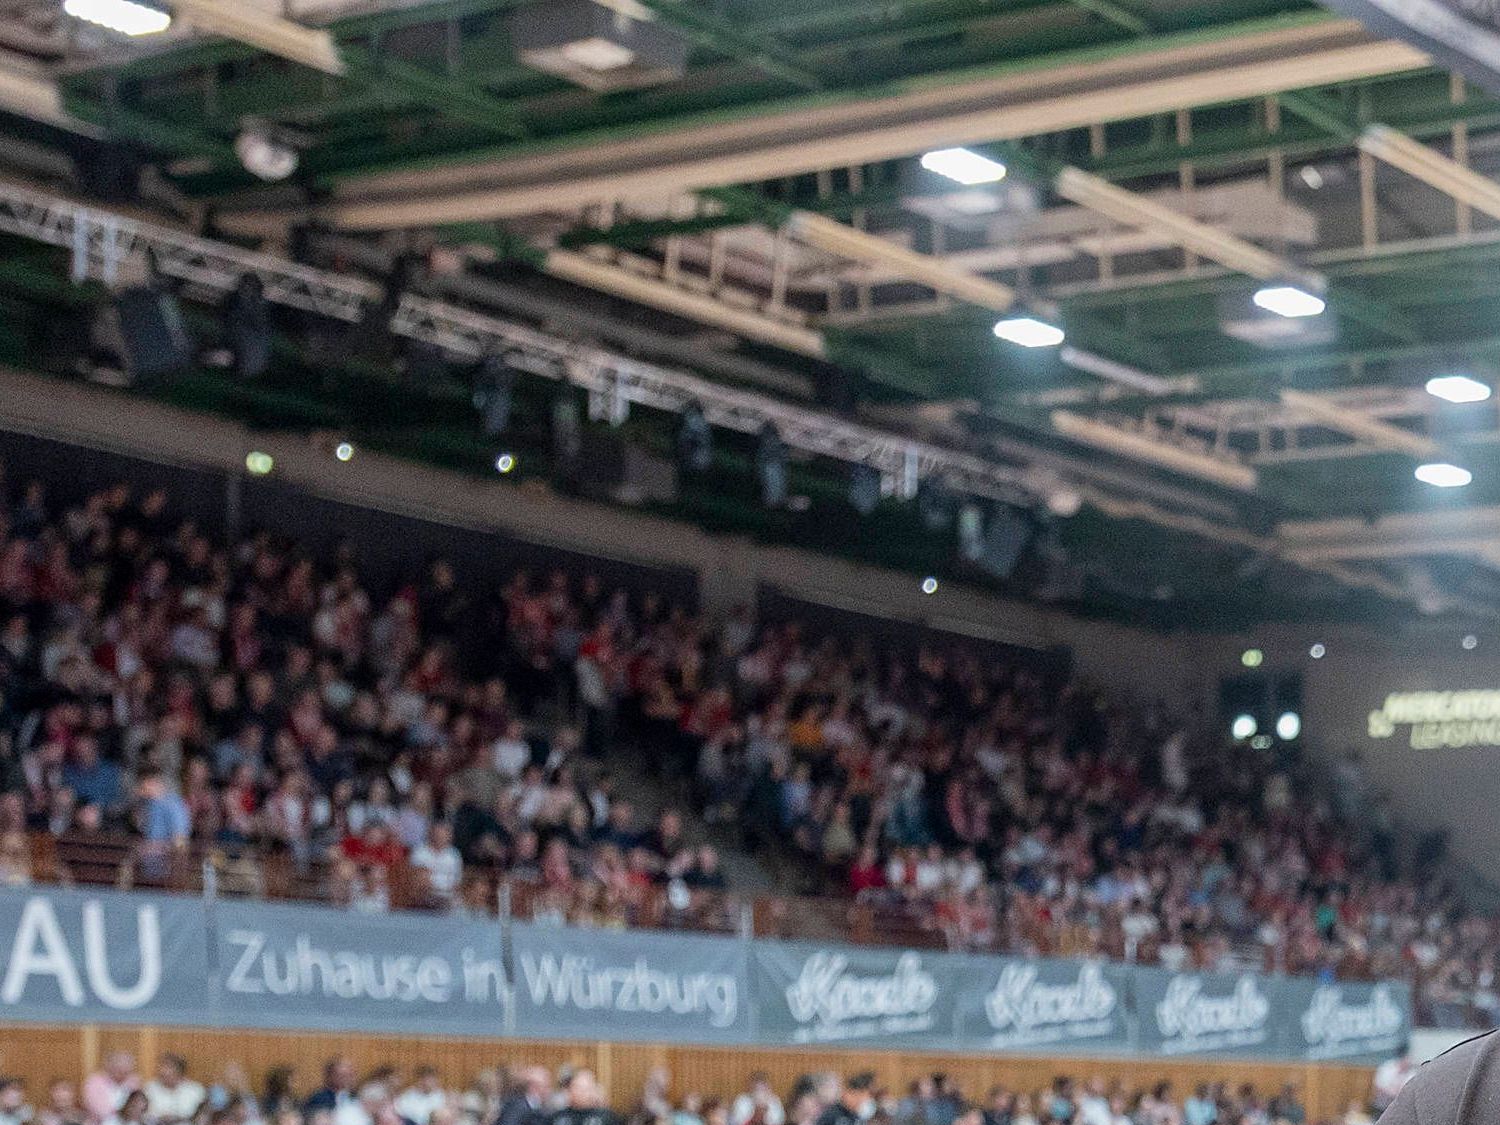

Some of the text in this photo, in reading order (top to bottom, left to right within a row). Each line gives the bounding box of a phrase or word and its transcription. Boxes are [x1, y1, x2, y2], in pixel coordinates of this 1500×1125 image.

[3, 897, 163, 1010] AU
[226, 929, 451, 1002] Zuhause
[460, 946, 501, 1002] in
[519, 950, 739, 1027] Würzburg
